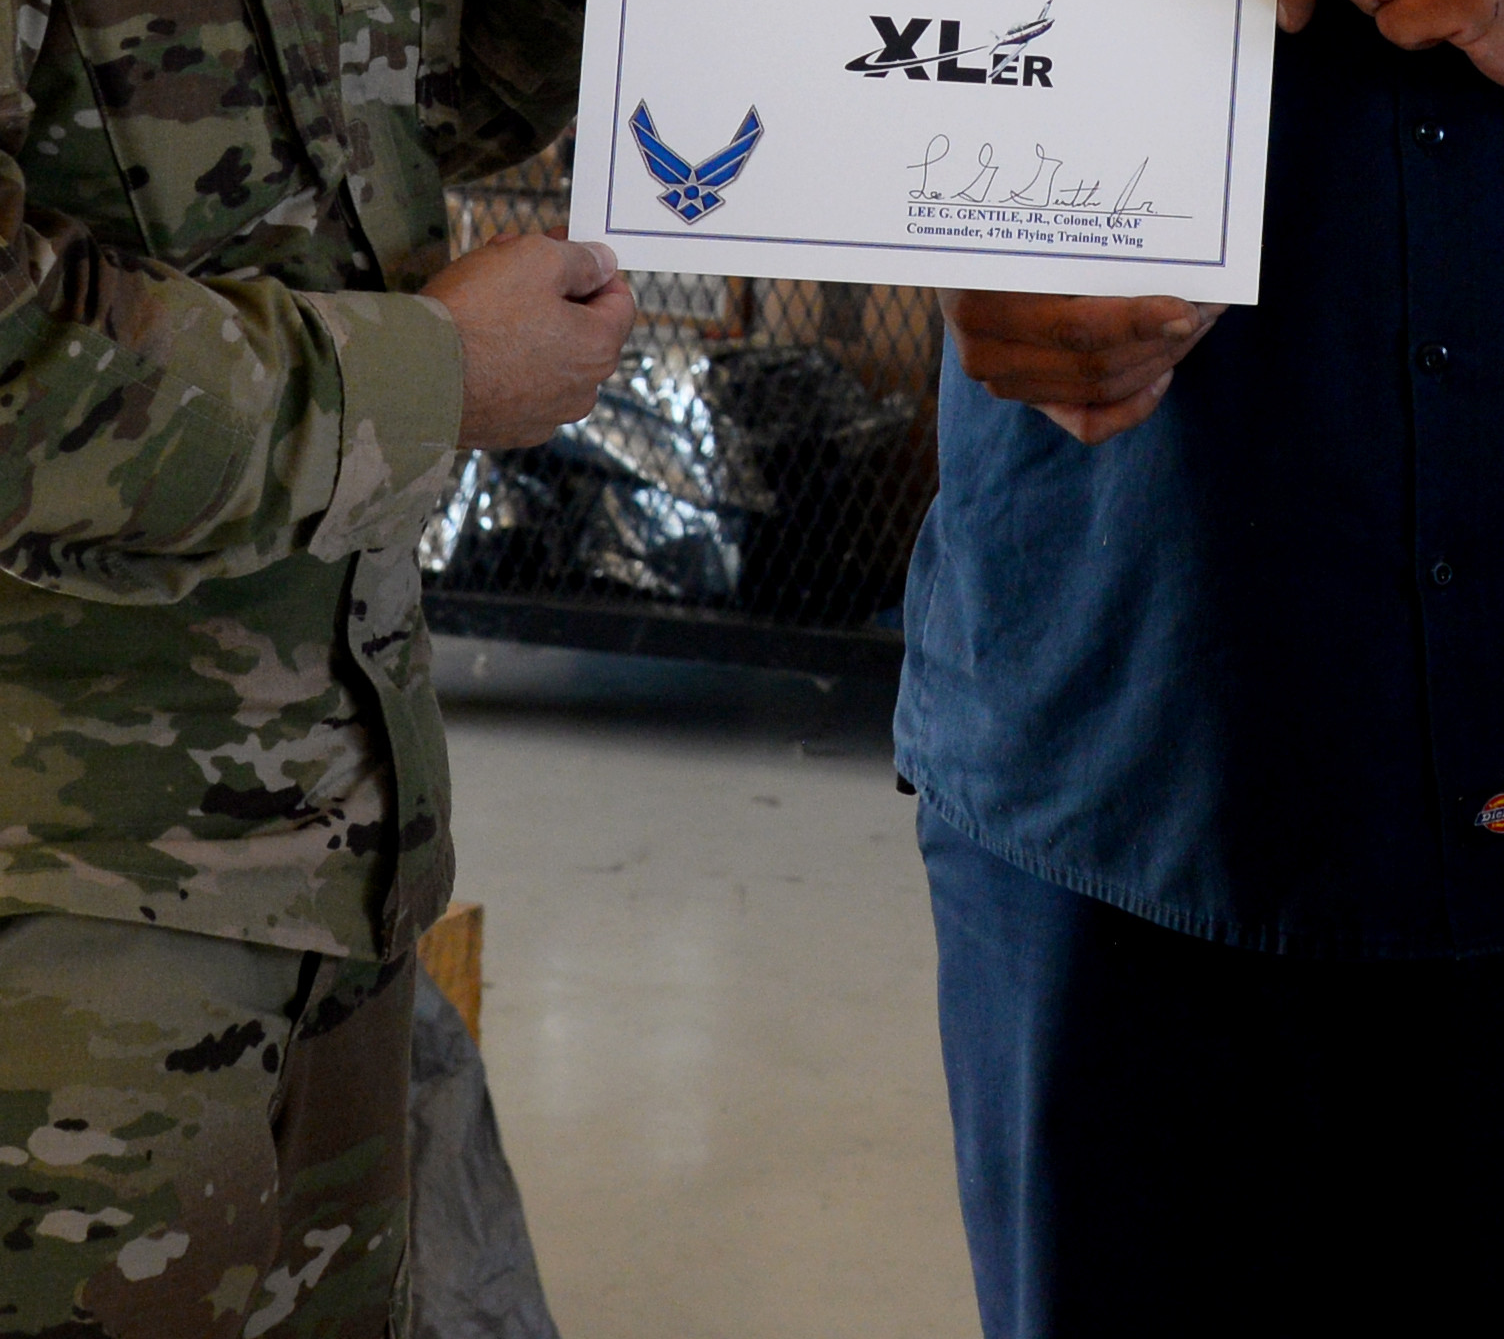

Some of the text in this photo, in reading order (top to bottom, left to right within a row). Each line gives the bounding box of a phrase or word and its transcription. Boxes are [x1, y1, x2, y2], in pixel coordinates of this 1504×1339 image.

[907, 206, 936, 219] LEE
[939, 208, 953, 219] G.
[957, 208, 1023, 223] GENTILE,
[1053, 214, 1102, 228] Colonel,
[1106, 216, 1142, 229] USAF
[906, 223, 1143, 248] Commander, 47th Flying Training Wing
